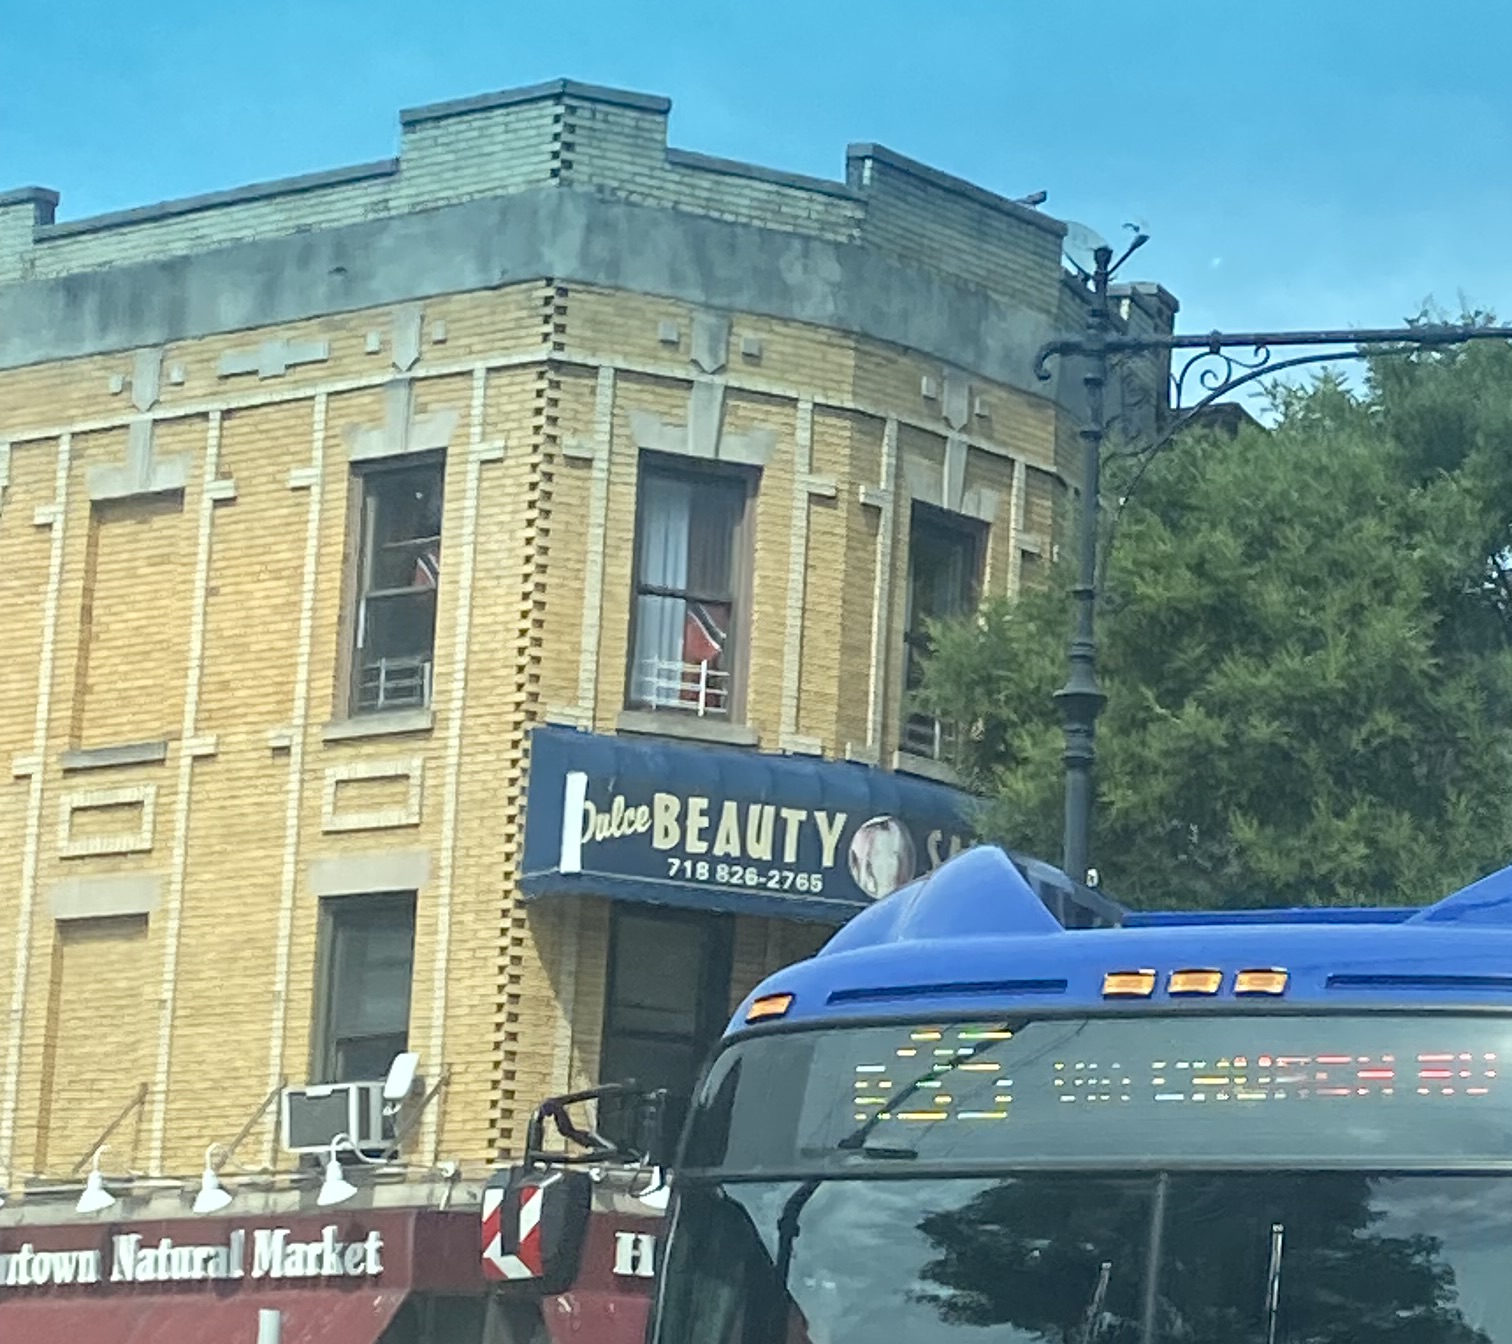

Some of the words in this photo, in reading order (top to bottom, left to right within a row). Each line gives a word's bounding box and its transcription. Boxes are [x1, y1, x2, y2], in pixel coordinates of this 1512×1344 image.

[652, 792, 848, 867] BEAUTY
[667, 858, 709, 880] 718
[716, 863, 823, 893] 826-2765
[111, 1229, 244, 1282] Natural
[251, 1225, 384, 1278] Market
